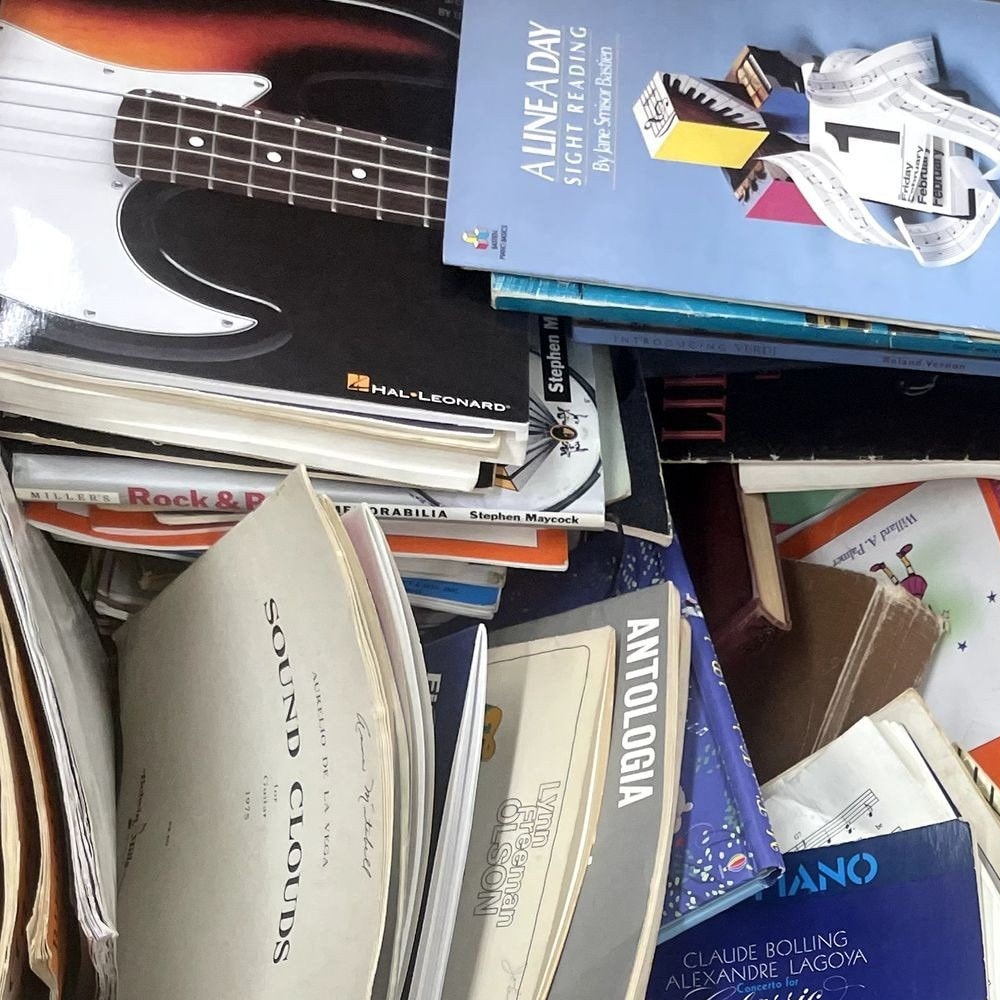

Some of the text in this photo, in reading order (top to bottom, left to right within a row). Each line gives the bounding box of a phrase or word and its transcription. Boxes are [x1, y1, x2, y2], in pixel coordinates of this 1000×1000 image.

[520, 20, 562, 182] A LINE A DAY
[564, 26, 588, 187] SIGHT READING
[592, 46, 614, 173] By Jane Bastien
[901, 161, 914, 202] Friday
[547, 331, 563, 394] Stephen
[29, 486, 241, 511] MILLER'S Rock &
[469, 509, 580, 526] Stephen Maycock
[878, 511, 919, 544] Willard
[616, 617, 661, 809] ANTOLOGIA
[263, 597, 305, 966] SOUND CLOUDS
[310, 670, 331, 869] AURELIO DE LA VEGA
[530, 780, 561, 849] Lynn
[472, 797, 523, 917] OLSON
[496, 804, 536, 928] Freeman
[664, 947, 869, 992] ALEXANDRE LAGOYA
[682, 930, 850, 970] CLAUDE BOLLING
[736, 976, 800, 996] Concerto for
